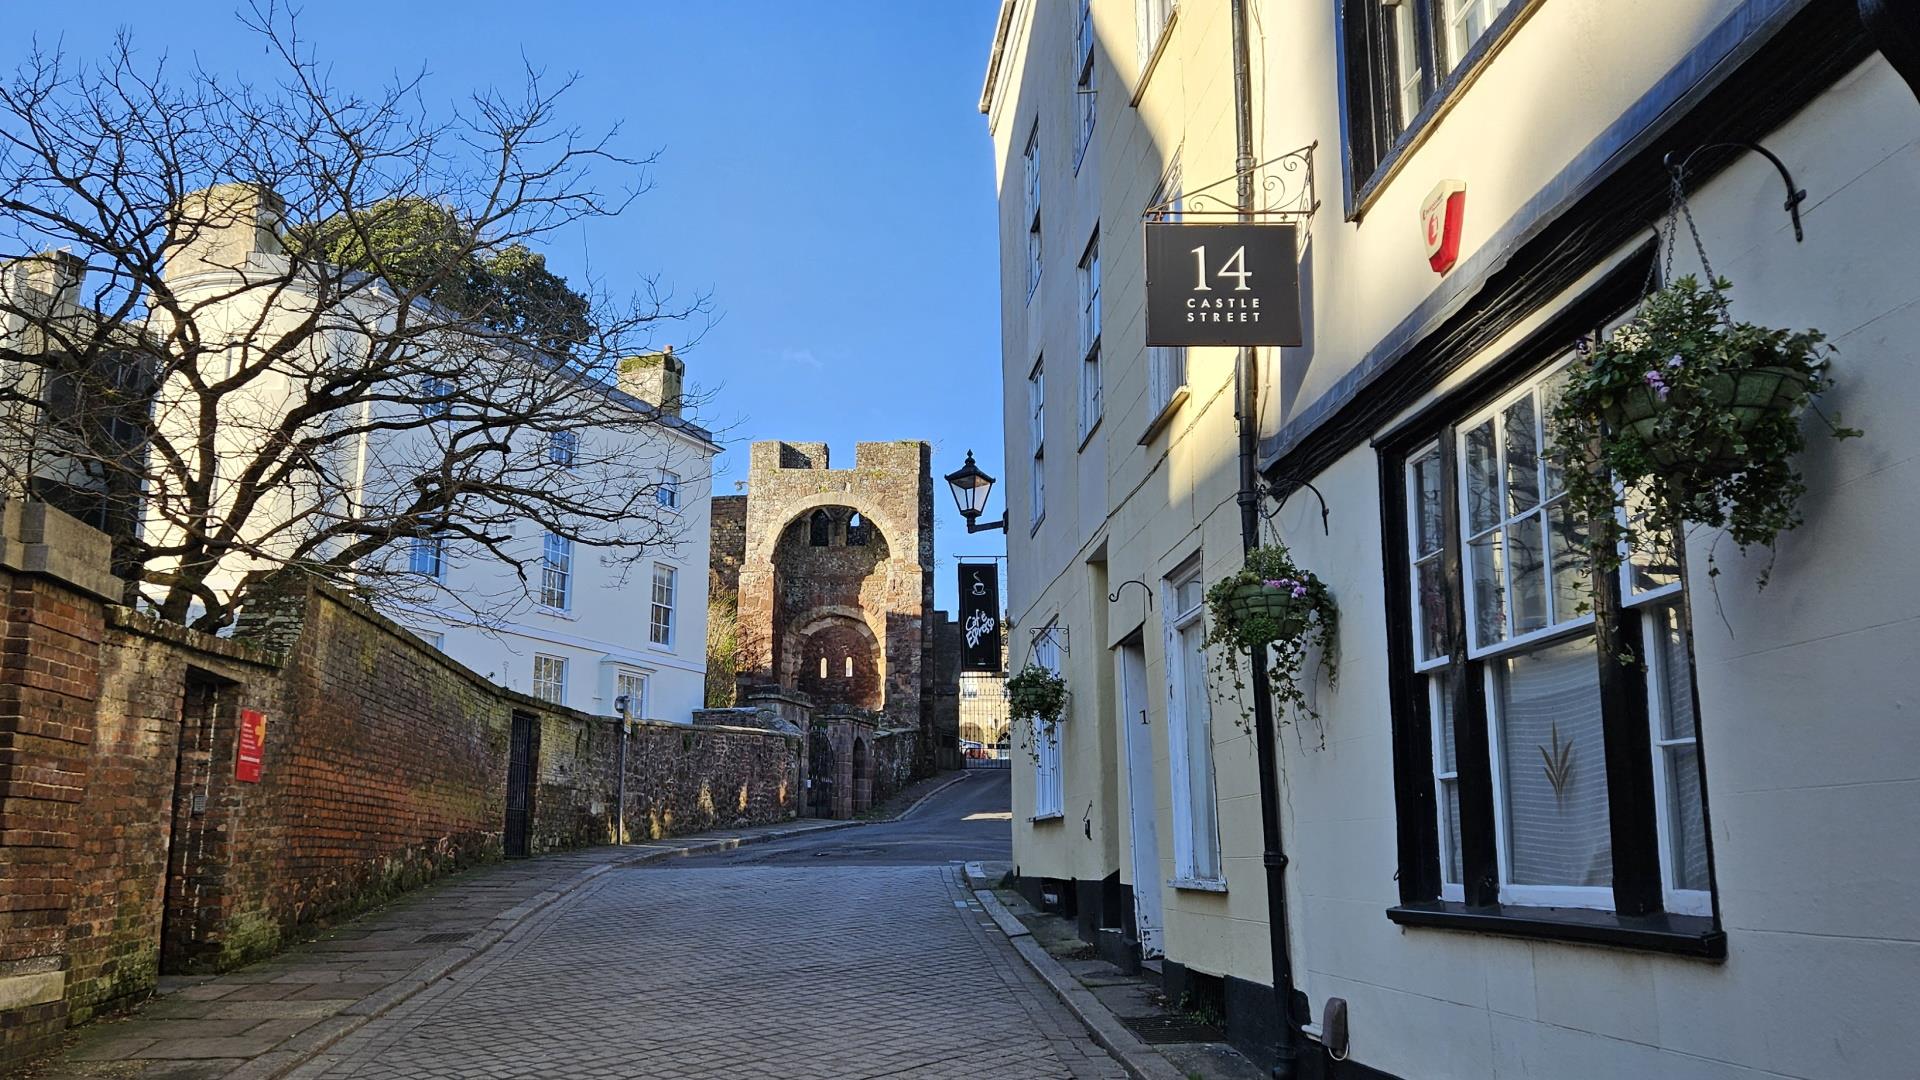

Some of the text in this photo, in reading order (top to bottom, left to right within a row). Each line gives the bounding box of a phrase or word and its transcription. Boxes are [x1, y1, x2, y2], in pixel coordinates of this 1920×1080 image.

[1191, 245, 1253, 291] 14
[1187, 298, 1260, 308] CASTLE
[1187, 312, 1260, 322] STREET
